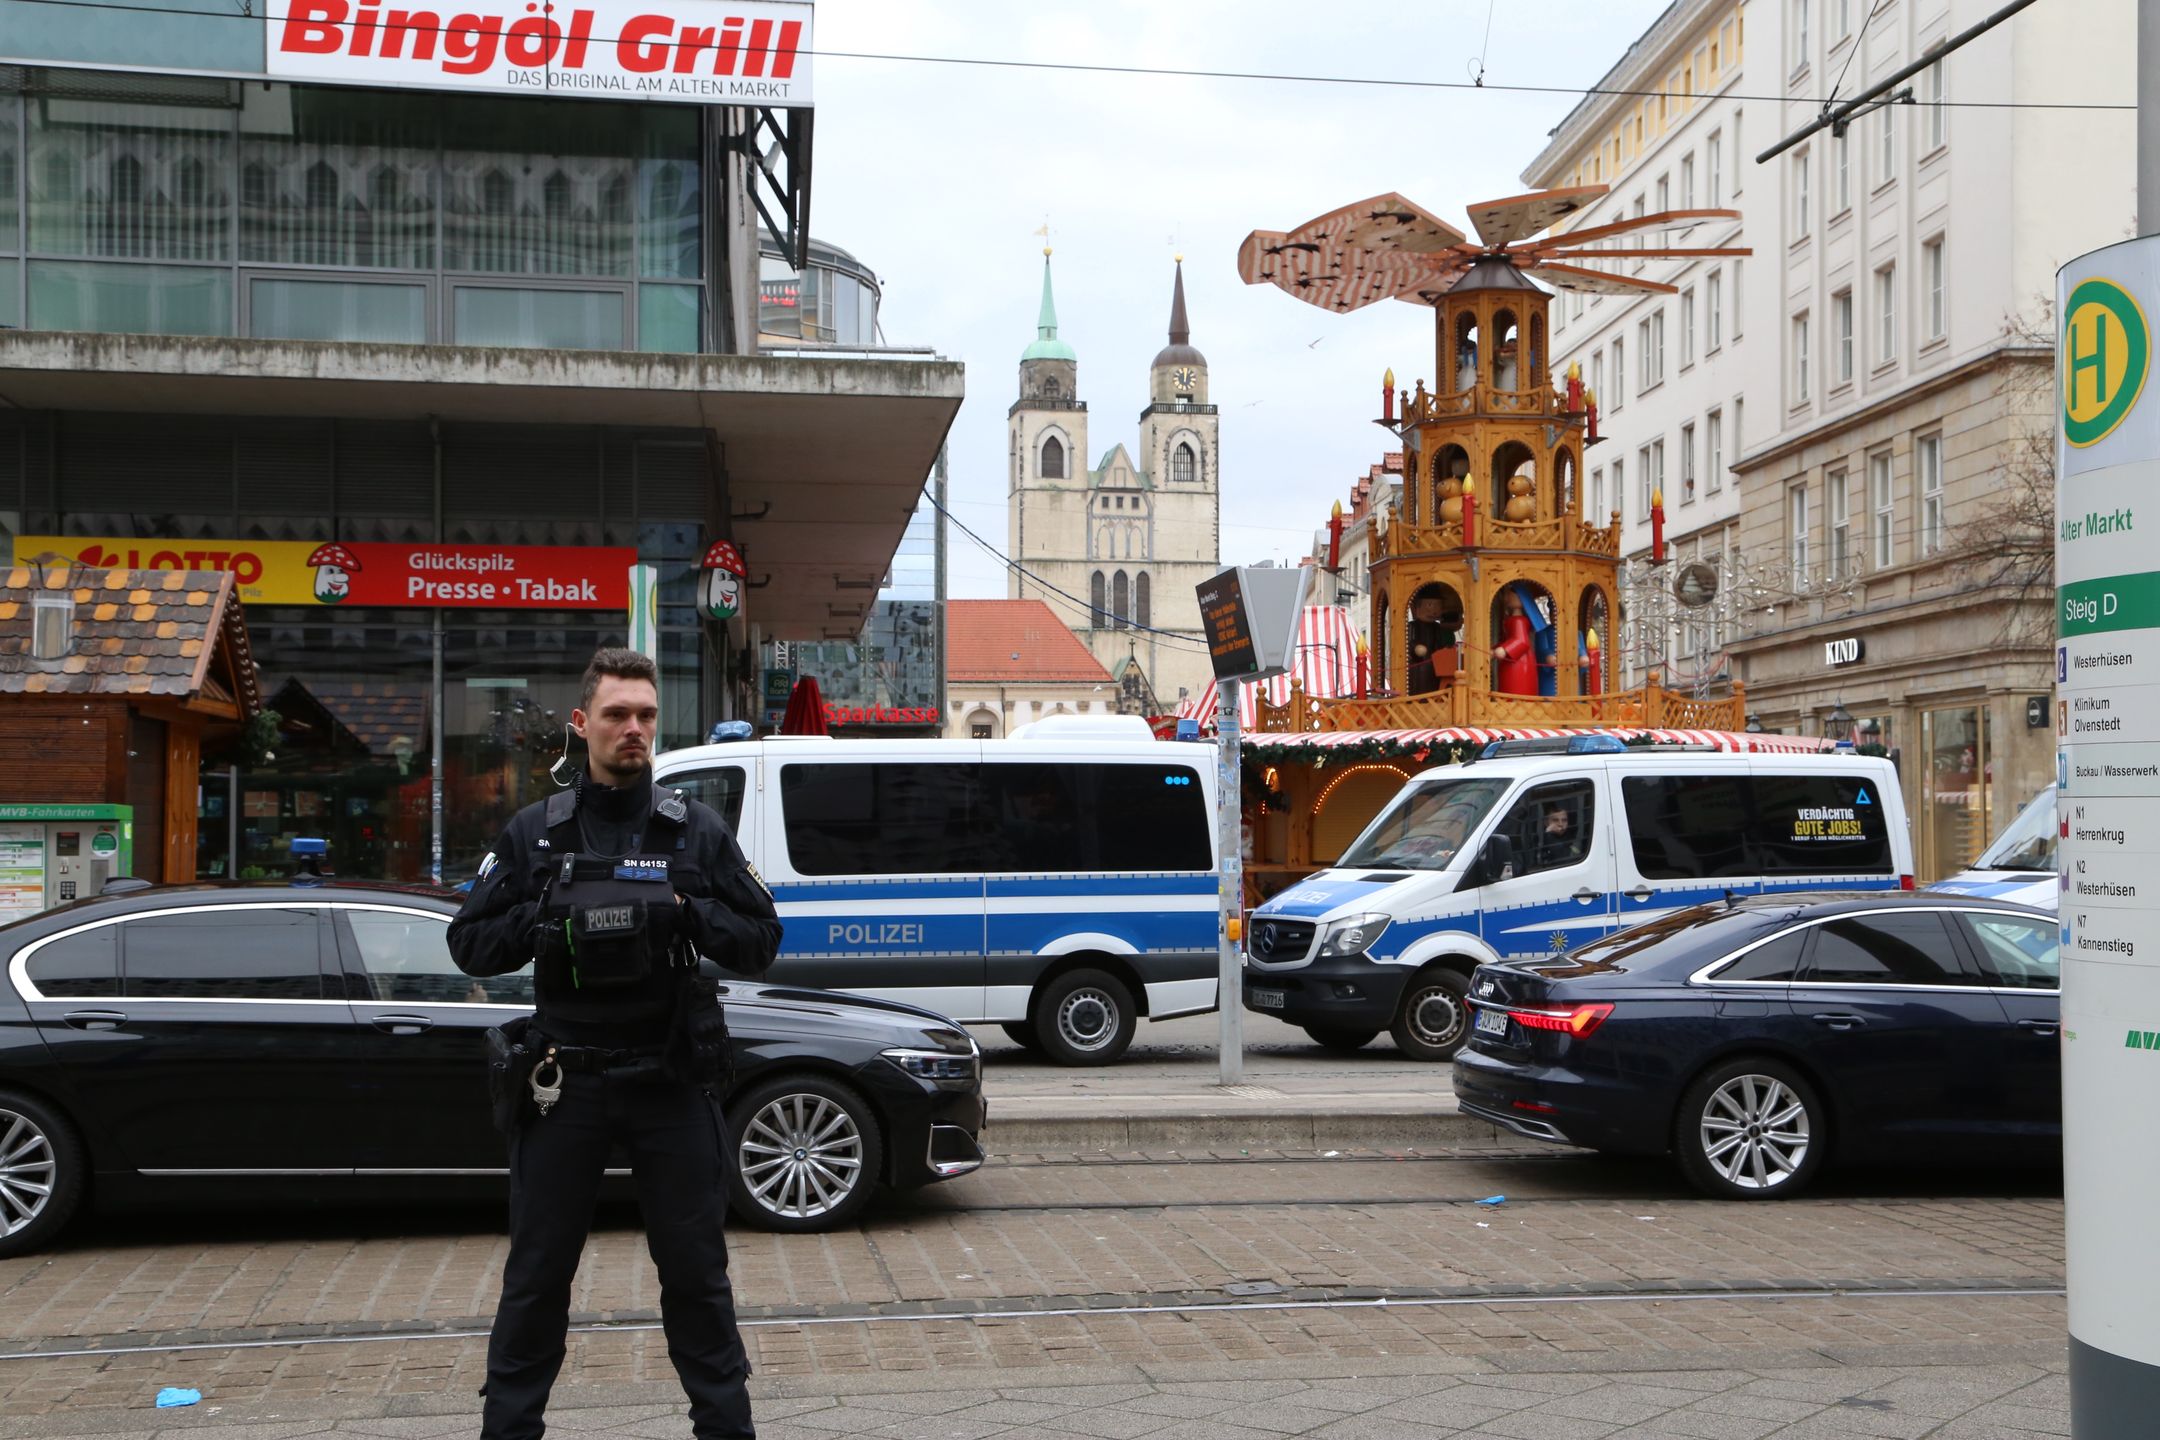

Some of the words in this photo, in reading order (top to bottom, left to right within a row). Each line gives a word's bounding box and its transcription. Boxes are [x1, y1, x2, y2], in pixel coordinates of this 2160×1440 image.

[280, 0, 595, 75] Bingöl
[616, 14, 802, 79] Grill
[507, 69, 542, 86] DAS
[548, 72, 631, 91] ORIGINAL
[636, 77, 663, 93] AM
[668, 78, 723, 95] ALTEN
[730, 81, 791, 98] MARKT
[2071, 312, 2107, 412] H
[2060, 519, 2083, 543] Alter
[2086, 508, 2133, 537] Markt
[408, 552, 515, 574] Glückspilz
[408, 576, 496, 599] Presse
[516, 578, 598, 602] Tabak
[2065, 596, 2098, 623] Steig
[2103, 593, 2118, 616] D
[1826, 638, 1859, 665] KIND
[2059, 653, 2064, 678] 2
[2073, 652, 2133, 669] Westerhüsen
[2074, 696, 2110, 711] Klinikum
[823, 703, 938, 726] Sparkasse
[2059, 707, 2065, 733] 5
[2074, 716, 2121, 733] Olvenstedt
[2076, 766, 2099, 777] Buckau
[2104, 764, 2159, 777] Wasserwerk
[1797, 806, 1854, 820] VERDÄCHTIG
[2076, 806, 2085, 819] N1
[1794, 821, 1825, 835] GUTE
[1828, 821, 1861, 835] JOBS!
[2076, 827, 2125, 845] Herrenkrug
[623, 859, 638, 868] SN
[639, 859, 667, 868] 64152
[2076, 860, 2086, 874] N2
[2076, 881, 2136, 897] Westerhüsen
[588, 908, 632, 928] POLIZEI
[2077, 915, 2087, 929] N7
[828, 924, 924, 944] POLIZEI
[2077, 935, 2134, 957] Kannenstieg
